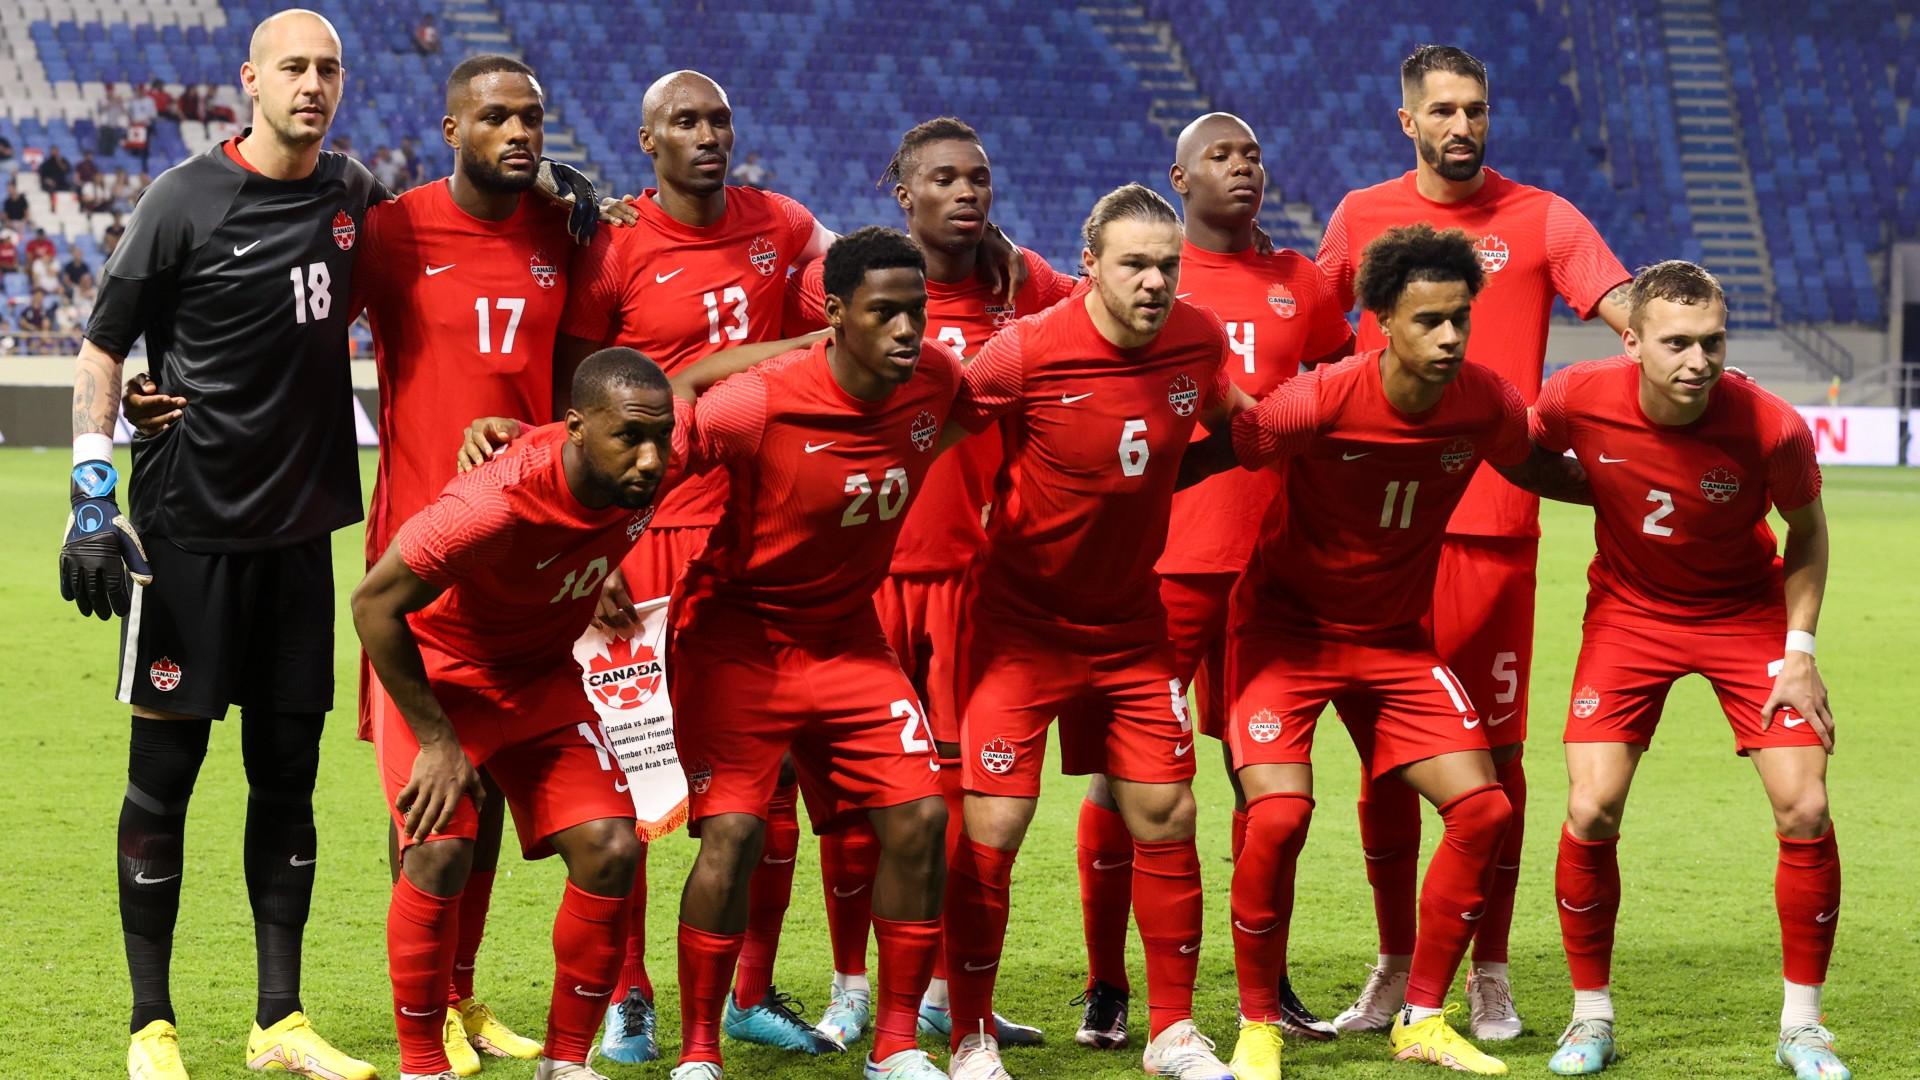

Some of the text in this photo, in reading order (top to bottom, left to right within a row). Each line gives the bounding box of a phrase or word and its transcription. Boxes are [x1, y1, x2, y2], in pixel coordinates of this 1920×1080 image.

[333, 226, 356, 235] CANADA
[751, 251, 777, 263] CANADA
[290, 262, 332, 324] 18
[1268, 297, 1295, 305] CANADA
[703, 286, 749, 344] 13
[985, 304, 1014, 313] CANAA
[475, 297, 526, 354] 17
[1225, 322, 1256, 374] 4
[1169, 391, 1198, 402] CANADA
[912, 426, 937, 441] CANADA
[1118, 419, 1150, 476] 6
[1442, 453, 1473, 461] CANADA
[840, 467, 909, 528] 20
[1701, 482, 1738, 491] CANADA
[1379, 480, 1420, 529] 11
[1643, 489, 1675, 537] 2
[549, 555, 608, 604] 10
[151, 670, 179, 679] CANADA
[588, 661, 662, 686] CANADA
[1491, 651, 1518, 704] 5
[1168, 677, 1192, 733] 6
[605, 715, 665, 734] Canada vs Japan
[622, 763, 643, 774] nited
[645, 759, 661, 770] Arab
[982, 751, 1013, 760] CANADA
